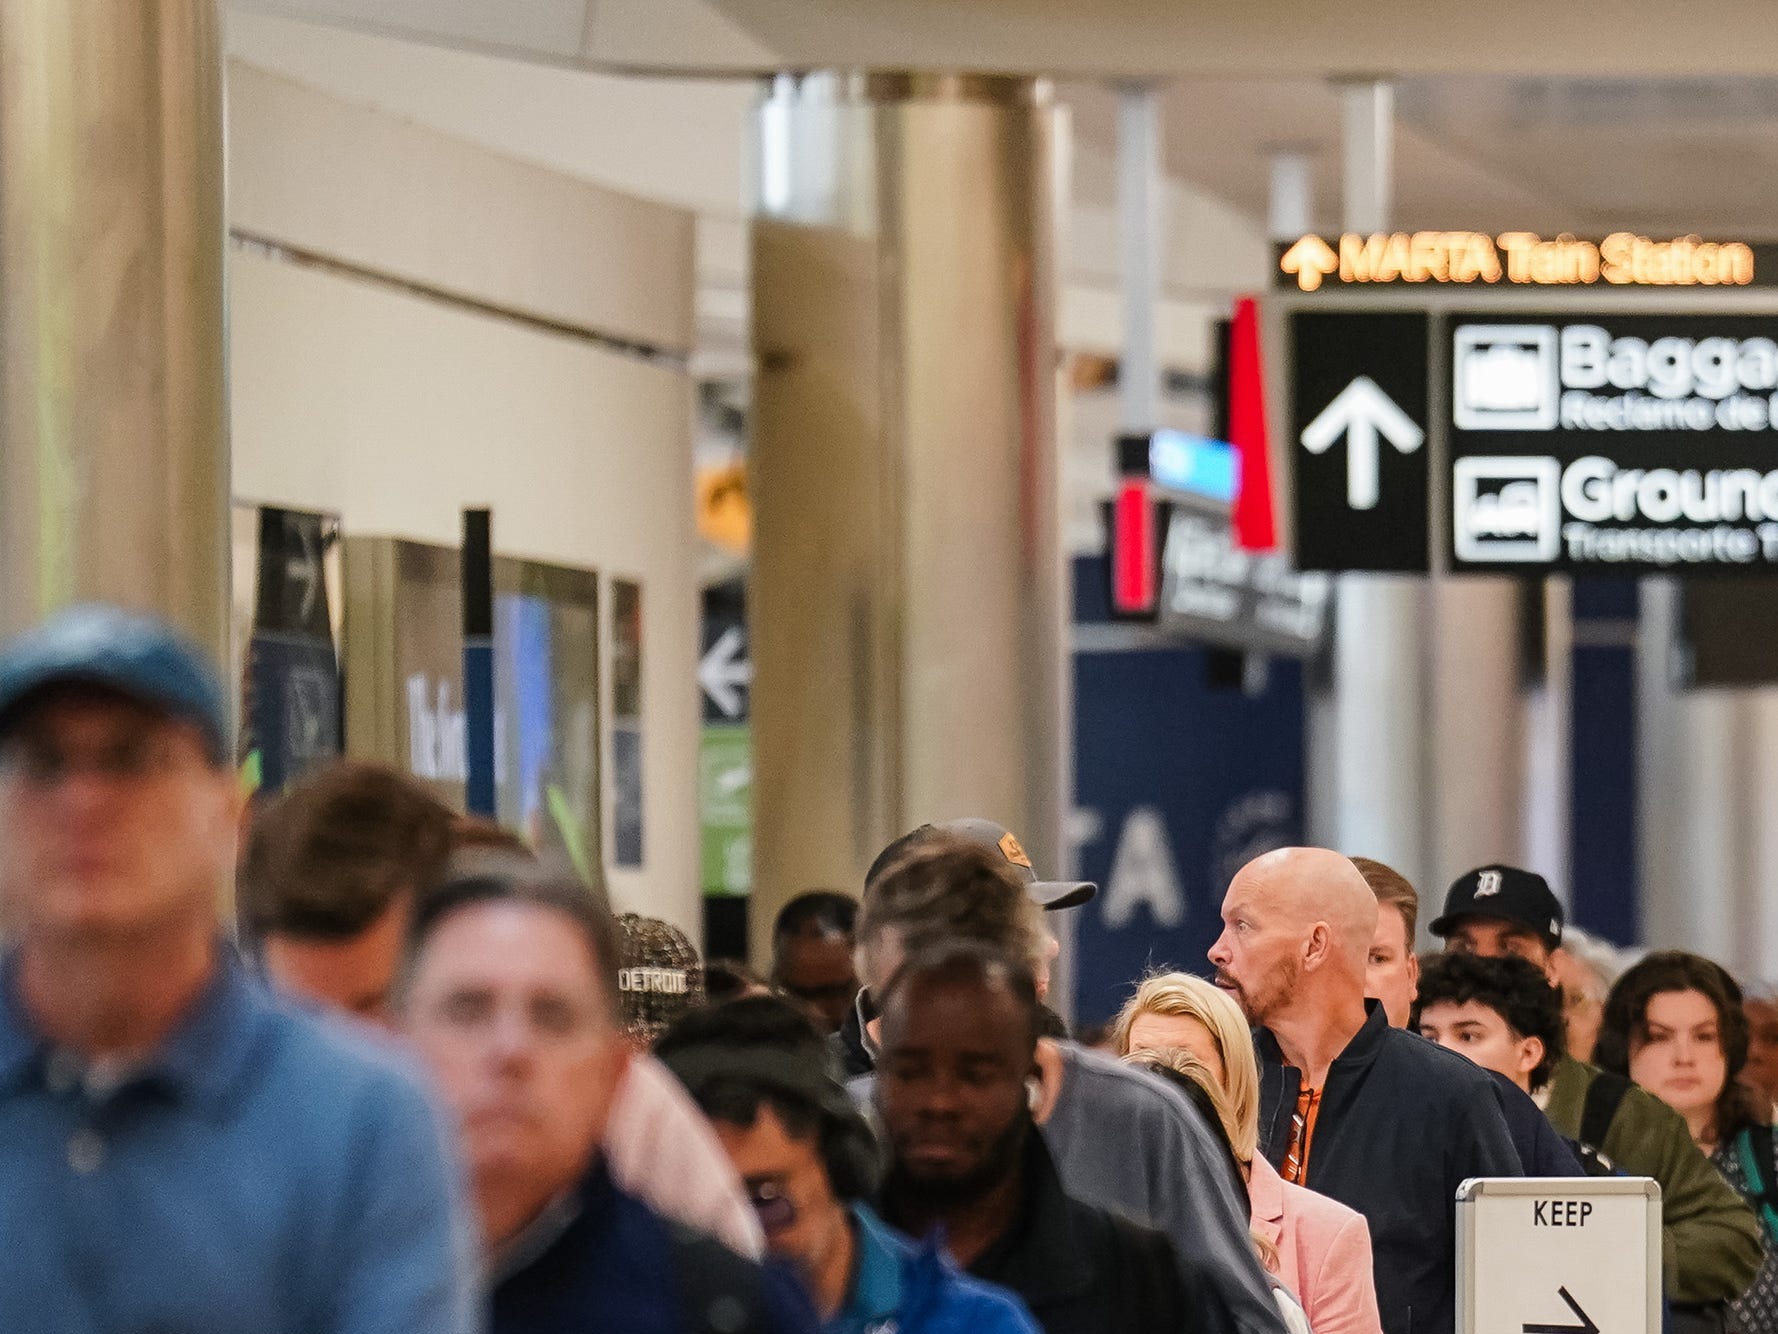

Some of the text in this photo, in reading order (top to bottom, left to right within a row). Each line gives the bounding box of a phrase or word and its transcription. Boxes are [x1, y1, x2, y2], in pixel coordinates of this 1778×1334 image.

[1340, 231, 1754, 285] MARTA Train Station
[1473, 870, 1503, 899] D
[618, 966, 688, 994] DETROIT
[1533, 1200, 1593, 1227] KEEP
